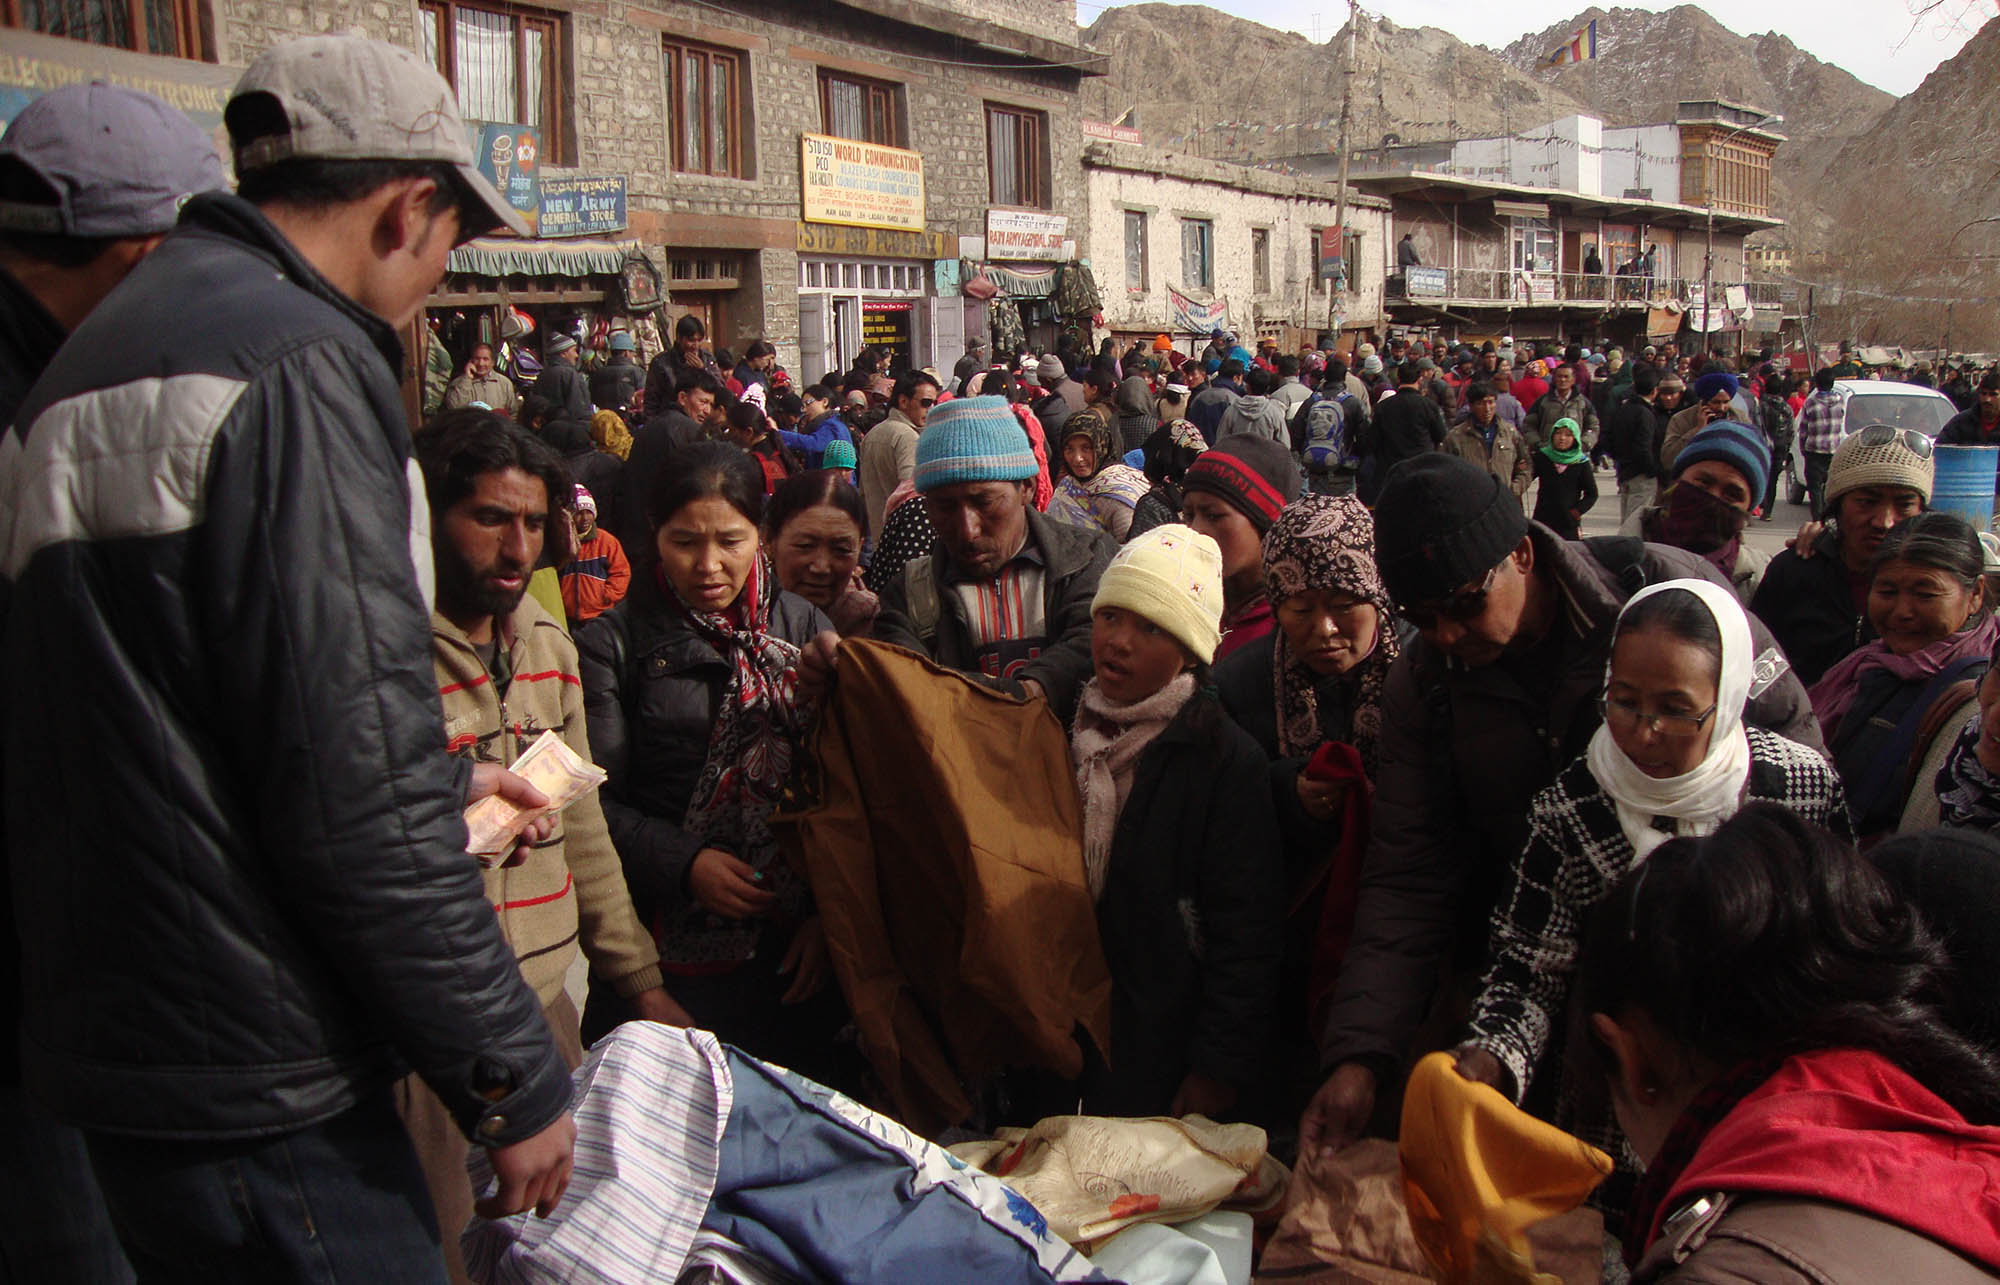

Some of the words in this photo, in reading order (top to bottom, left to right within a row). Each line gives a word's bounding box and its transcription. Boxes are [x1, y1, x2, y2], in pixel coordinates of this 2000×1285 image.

[815, 156, 829, 171] PCO
[834, 143, 861, 164] WORLD
[865, 149, 920, 172] COMMUNICATION
[545, 199, 573, 213] NEW
[579, 196, 617, 211] ARMY
[845, 191, 874, 203] BOOKING
[878, 195, 890, 205] FOR
[541, 211, 582, 225] GENERAL
[589, 210, 616, 222] STORE
[803, 223, 836, 249] STD
[1048, 234, 1065, 249] STORE
